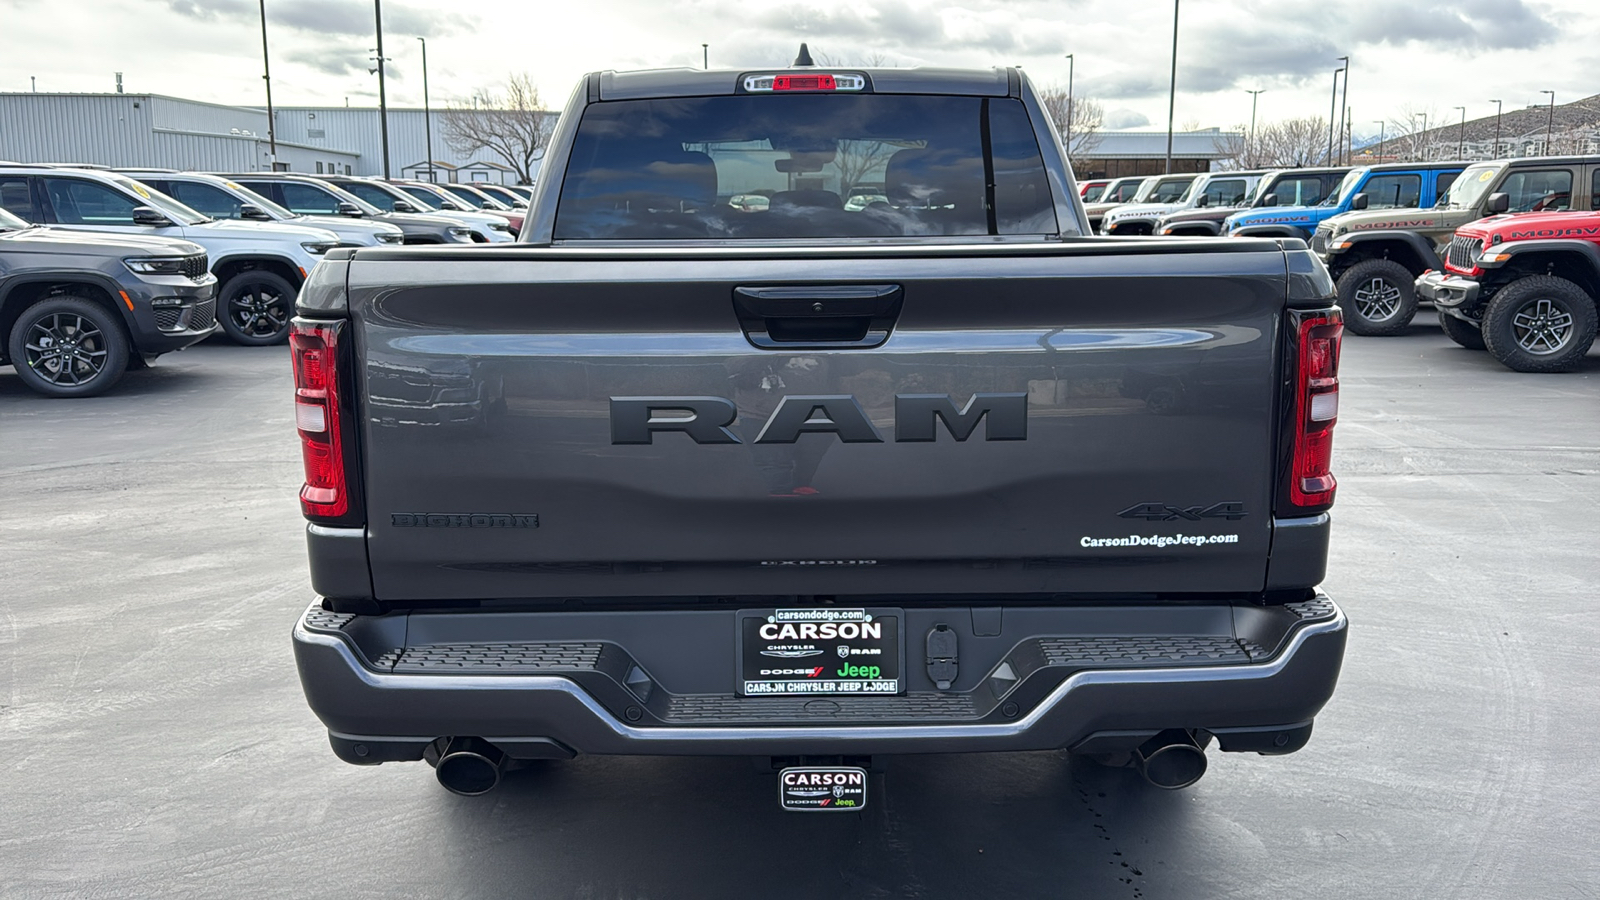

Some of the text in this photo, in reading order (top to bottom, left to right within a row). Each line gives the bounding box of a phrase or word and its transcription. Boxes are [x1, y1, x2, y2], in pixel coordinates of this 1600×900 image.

[1245, 216, 1309, 224] MOJAVE
[1353, 219, 1434, 230] MOJAVE
[609, 392, 1028, 446] RAM
[1116, 501, 1249, 521] 4x4
[391, 512, 540, 528] BIGHORN
[1080, 533, 1239, 548] CarsonDodgeJeep.com
[777, 610, 863, 621] carsondodge.com
[759, 623, 881, 640] CARSON
[837, 662, 880, 679] Jeep
[787, 682, 836, 692] CHRYSLER
[837, 682, 861, 691] JEEP
[784, 774, 862, 785] CARSON
[835, 799, 855, 807] Jeep
